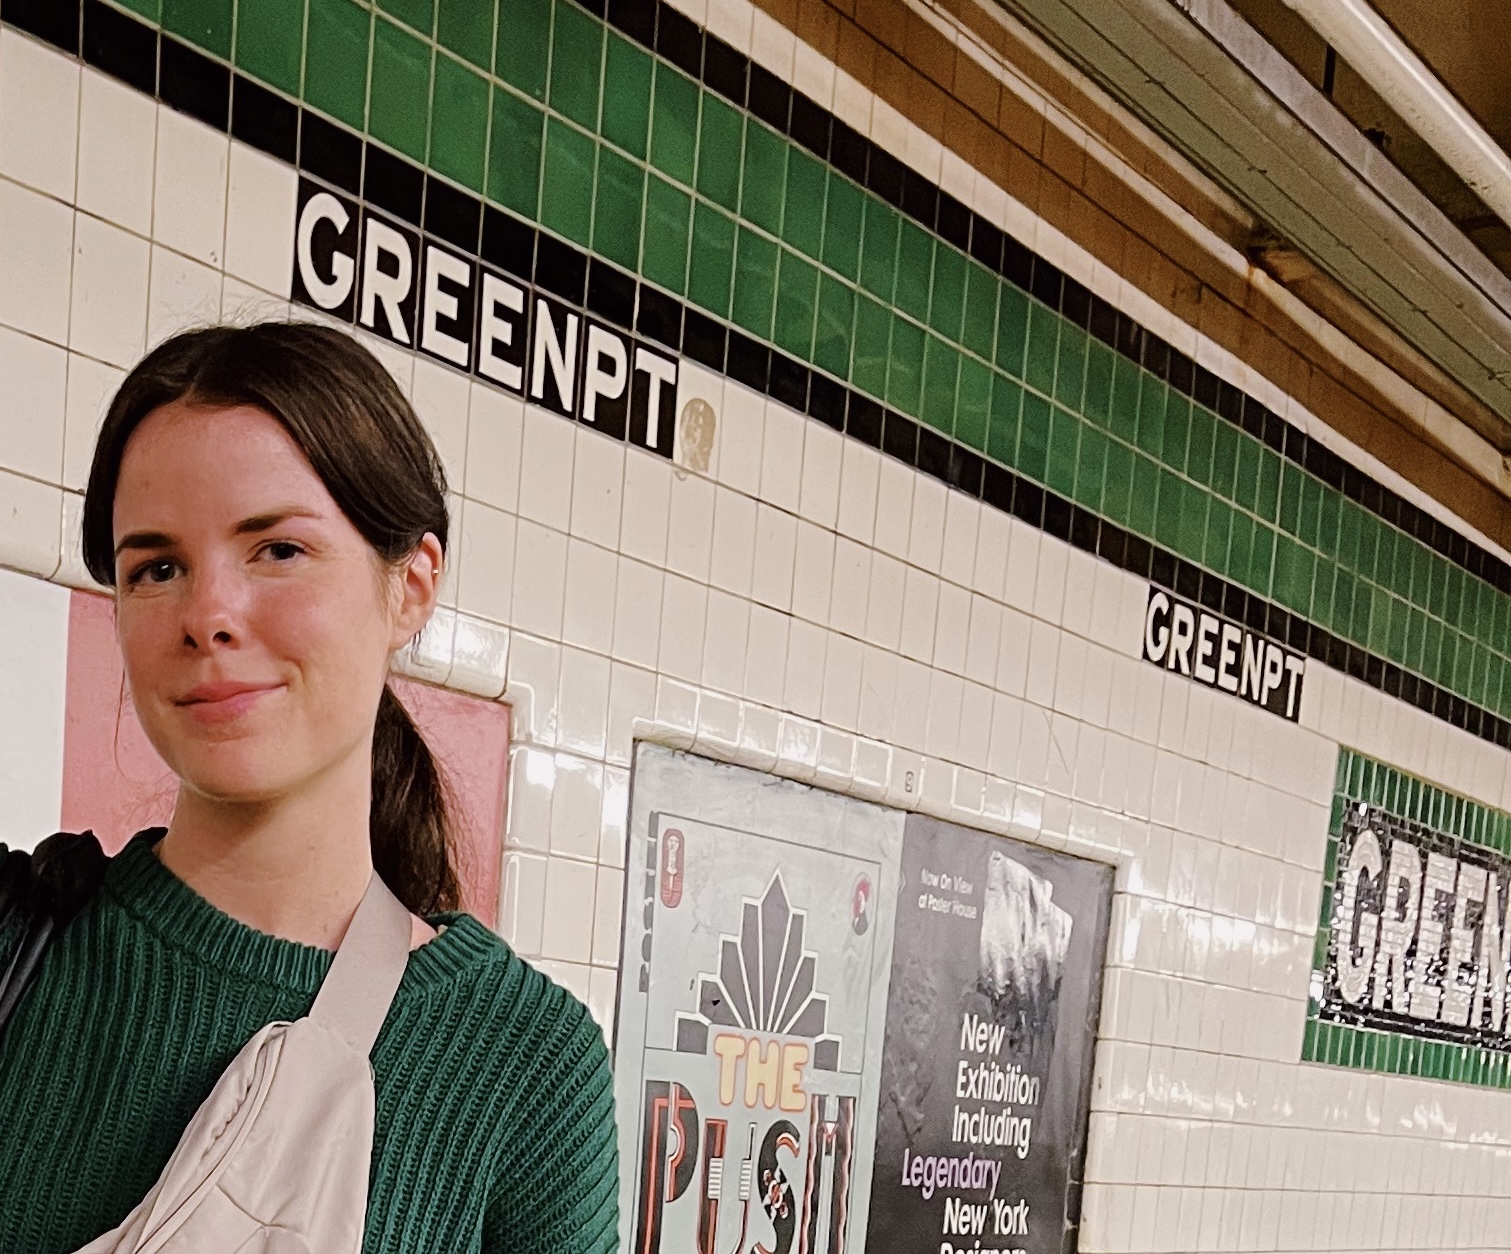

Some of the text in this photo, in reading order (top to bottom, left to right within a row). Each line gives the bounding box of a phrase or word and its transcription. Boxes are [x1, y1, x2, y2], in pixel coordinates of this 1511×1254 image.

[297, 192, 676, 449] GREENPT
[1145, 591, 1304, 718] GREENPT
[1338, 830, 1511, 1036] GREEN
[961, 1013, 1005, 1055] New
[714, 1033, 809, 1112] THE
[956, 1060, 1039, 1105] Exhibition
[952, 1105, 1032, 1159] Including
[902, 1148, 1002, 1200] Legendary
[943, 1198, 1030, 1235] New York
